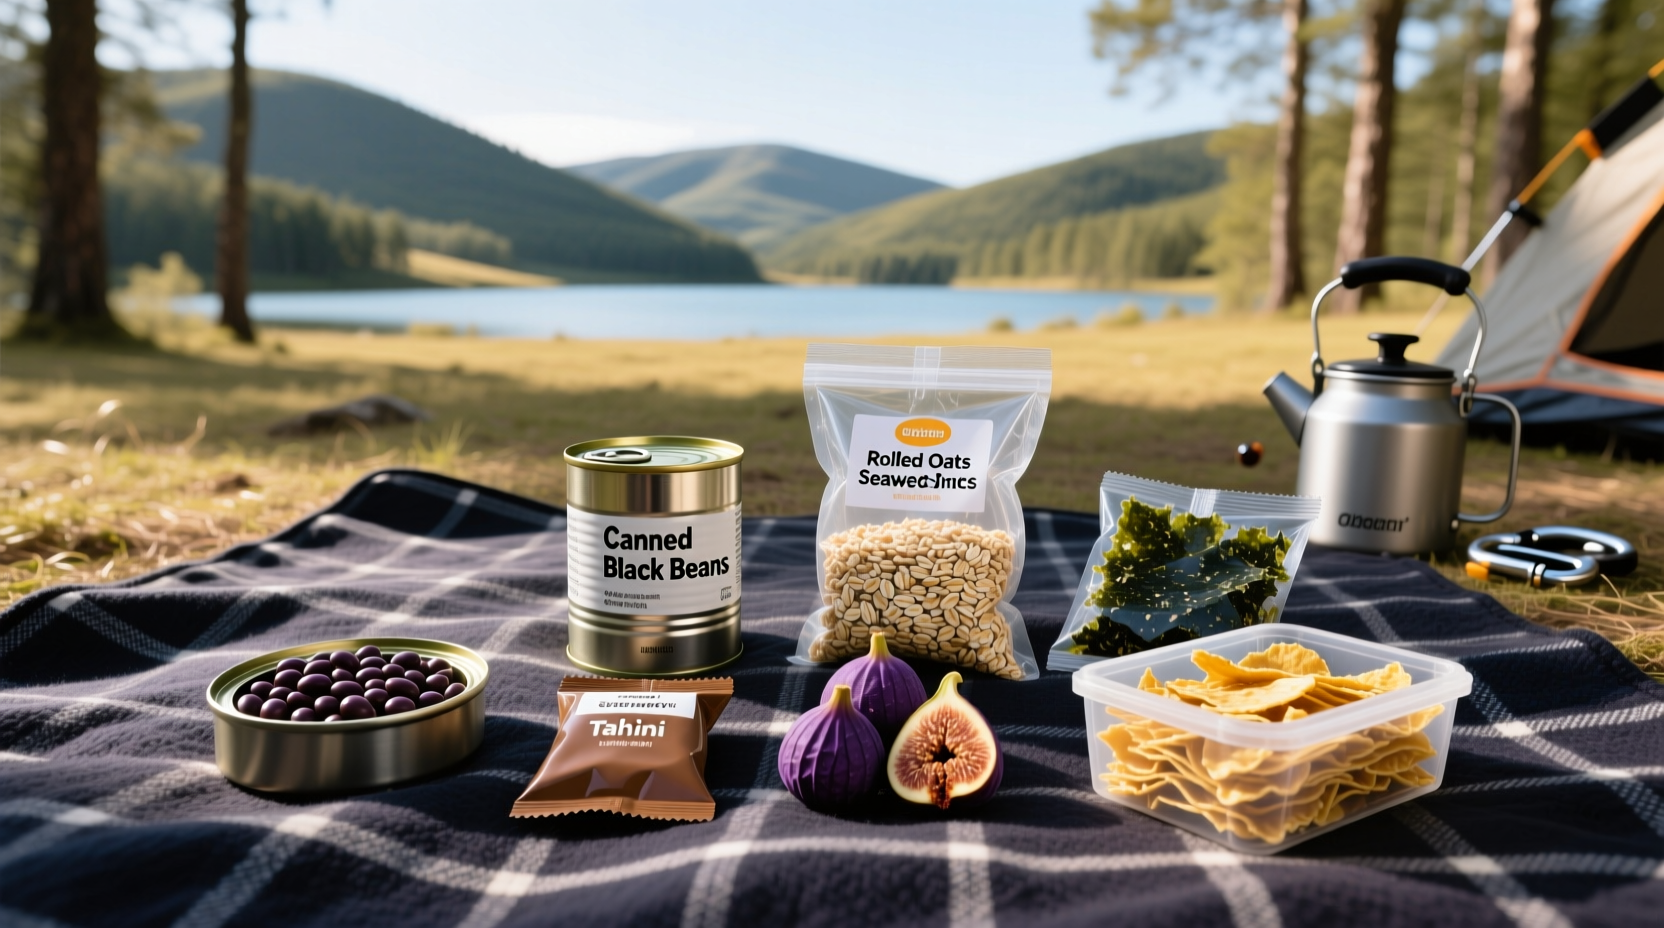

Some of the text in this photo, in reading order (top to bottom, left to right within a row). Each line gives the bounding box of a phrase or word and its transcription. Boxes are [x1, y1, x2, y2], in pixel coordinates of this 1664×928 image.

[867, 450, 971, 469] Rolled Oats
[603, 525, 693, 551] Canned
[603, 554, 730, 580] Black Beans
[589, 718, 666, 737] Tahini
